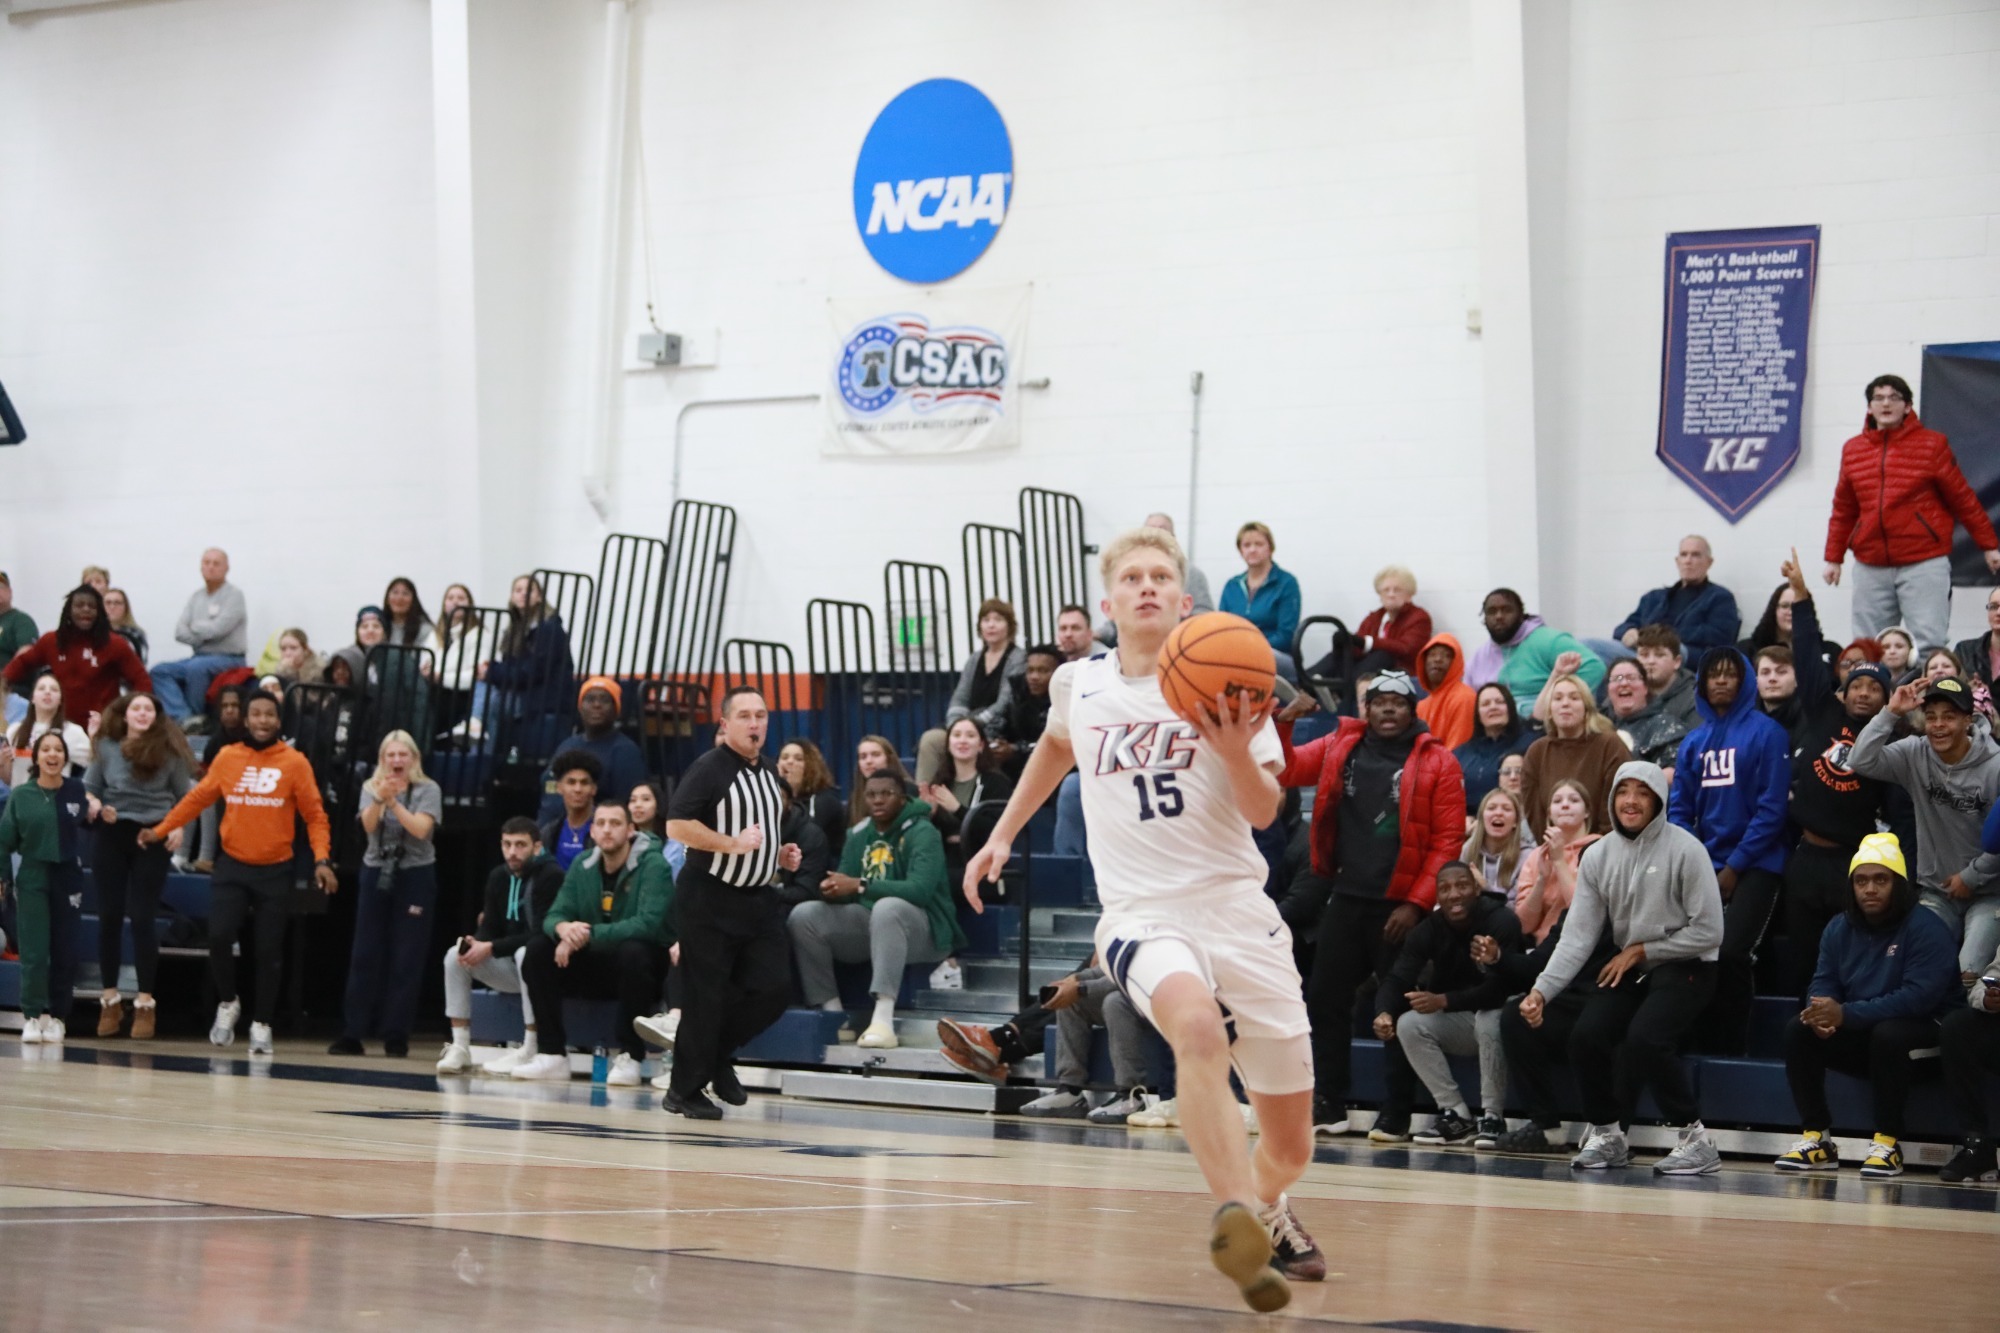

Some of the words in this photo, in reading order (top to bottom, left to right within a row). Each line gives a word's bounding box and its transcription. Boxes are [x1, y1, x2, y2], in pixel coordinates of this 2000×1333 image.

[866, 172, 1005, 235] NCAA
[1681, 269, 1715, 286] 1,000
[1717, 268, 1752, 282] Point
[1755, 267, 1804, 280] Scorers
[1686, 253, 1725, 268] Men's
[1728, 249, 1798, 266] Basketball
[890, 336, 1005, 388] CSAC
[1704, 437, 1767, 472] KC
[1088, 719, 1200, 776] KC
[1133, 772, 1184, 821] 15
